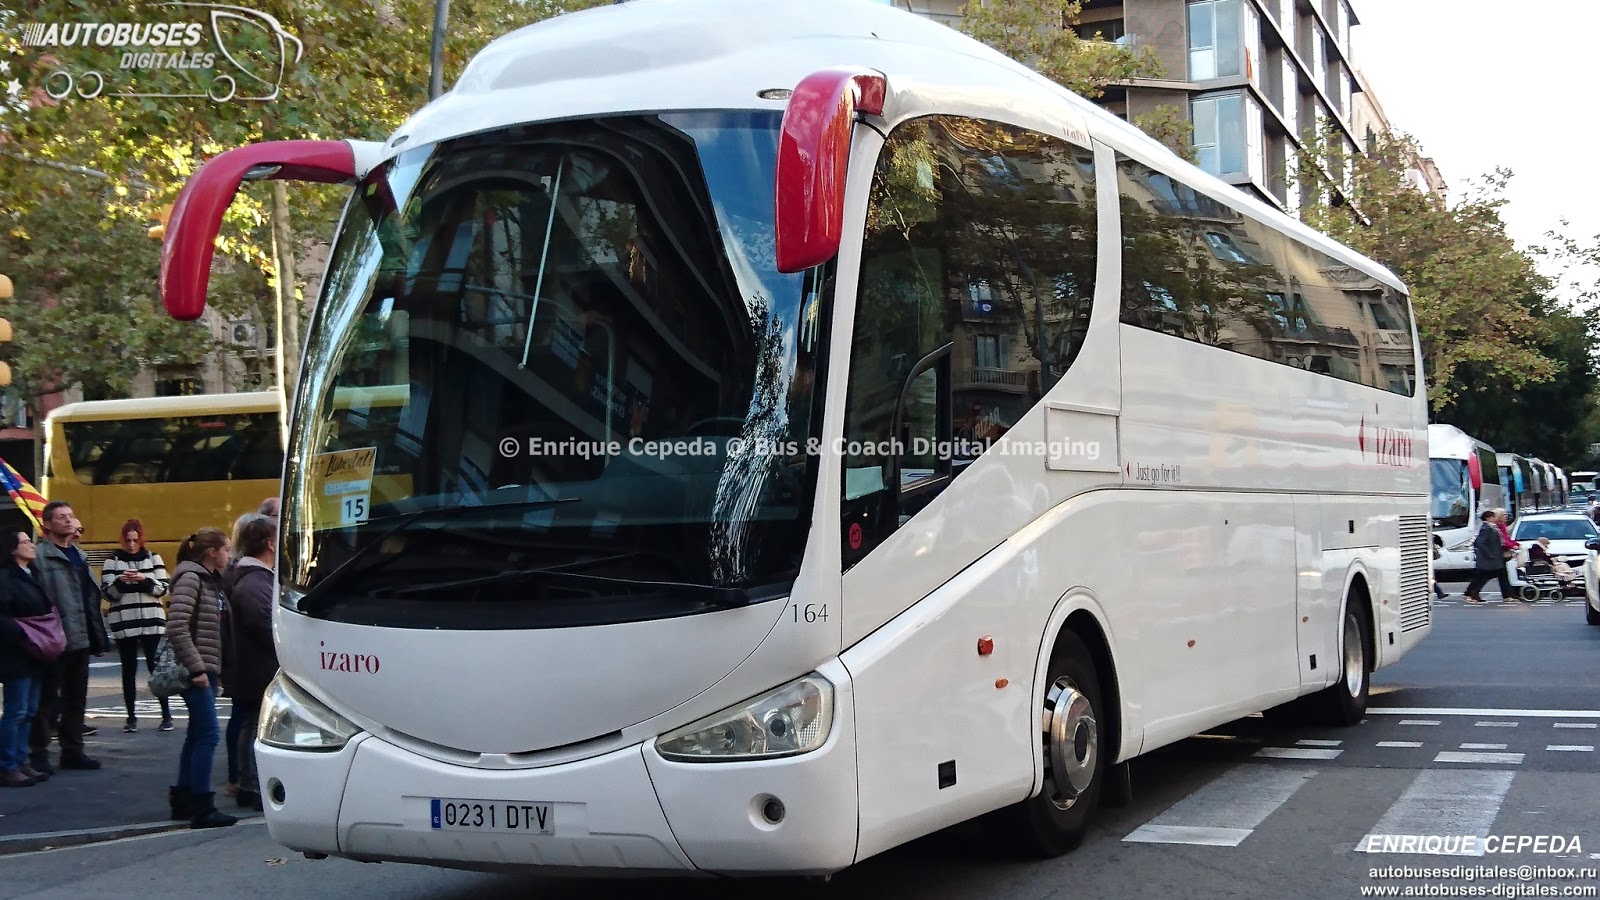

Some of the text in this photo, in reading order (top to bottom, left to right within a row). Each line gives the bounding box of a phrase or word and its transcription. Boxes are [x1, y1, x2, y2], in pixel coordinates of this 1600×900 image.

[1374, 402, 1412, 469] izaro
[1135, 462, 1149, 481] Just
[1151, 468, 1160, 486] go
[1160, 463, 1171, 482] for
[345, 498, 365, 519] 15
[791, 603, 829, 623] 164
[320, 640, 380, 674] izaro
[444, 802, 496, 828] 0231
[506, 804, 548, 830] DTV
